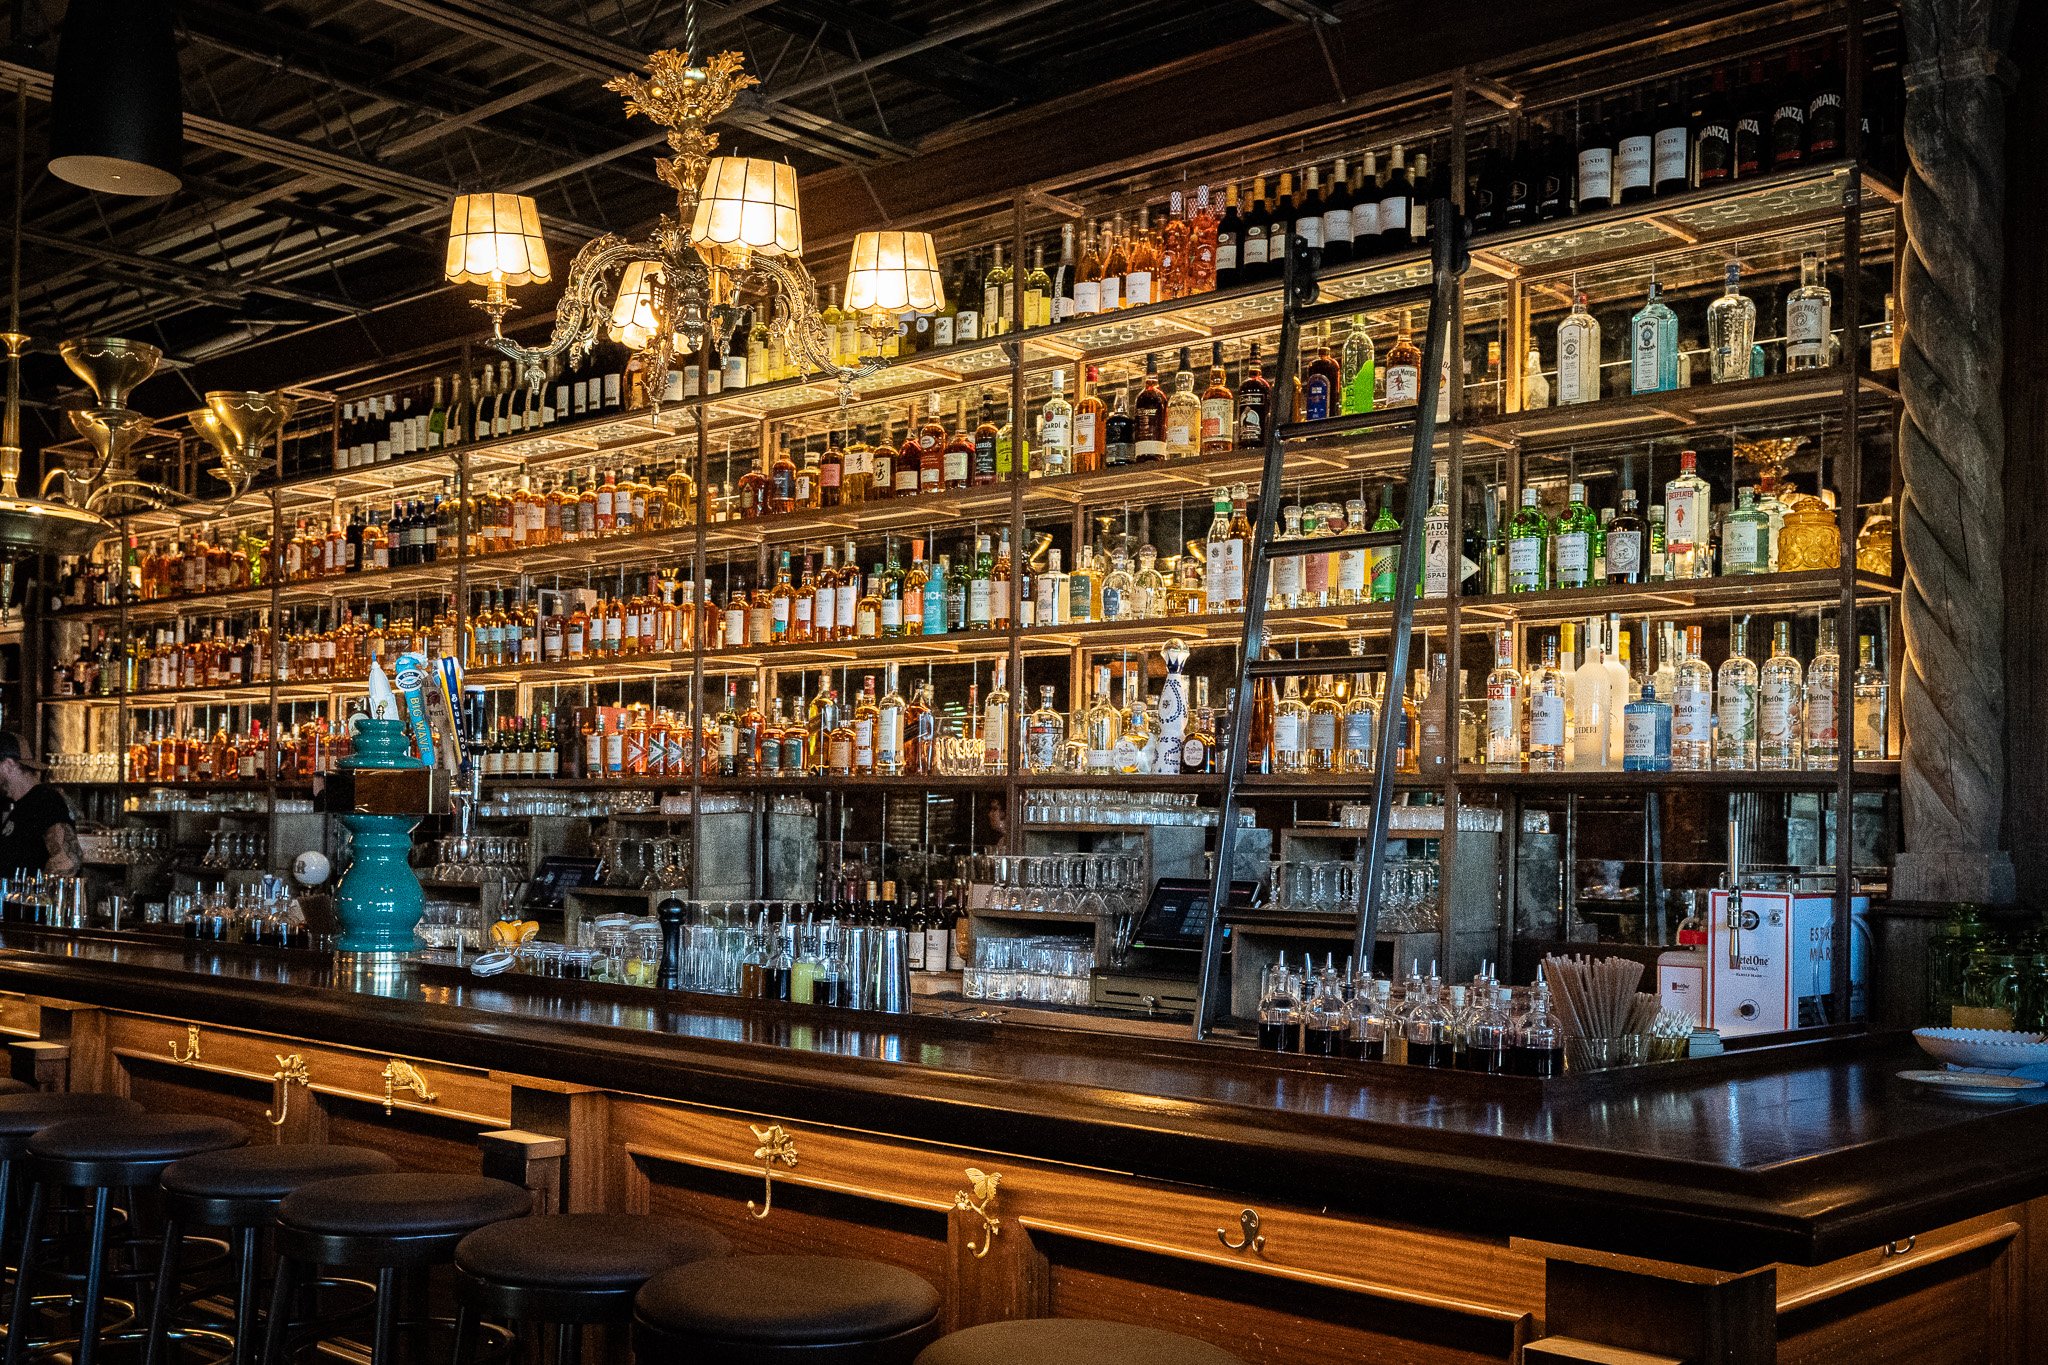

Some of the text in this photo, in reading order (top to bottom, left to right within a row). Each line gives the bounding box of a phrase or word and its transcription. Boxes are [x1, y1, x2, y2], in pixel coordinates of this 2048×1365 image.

[1054, 281, 1063, 321] CHANDON
[1668, 489, 1693, 501] BEEFEATER
[409, 696, 431, 752] BIG WAVE
[451, 693, 468, 757] BLUE MOON
[1739, 955, 1768, 966] etel One
